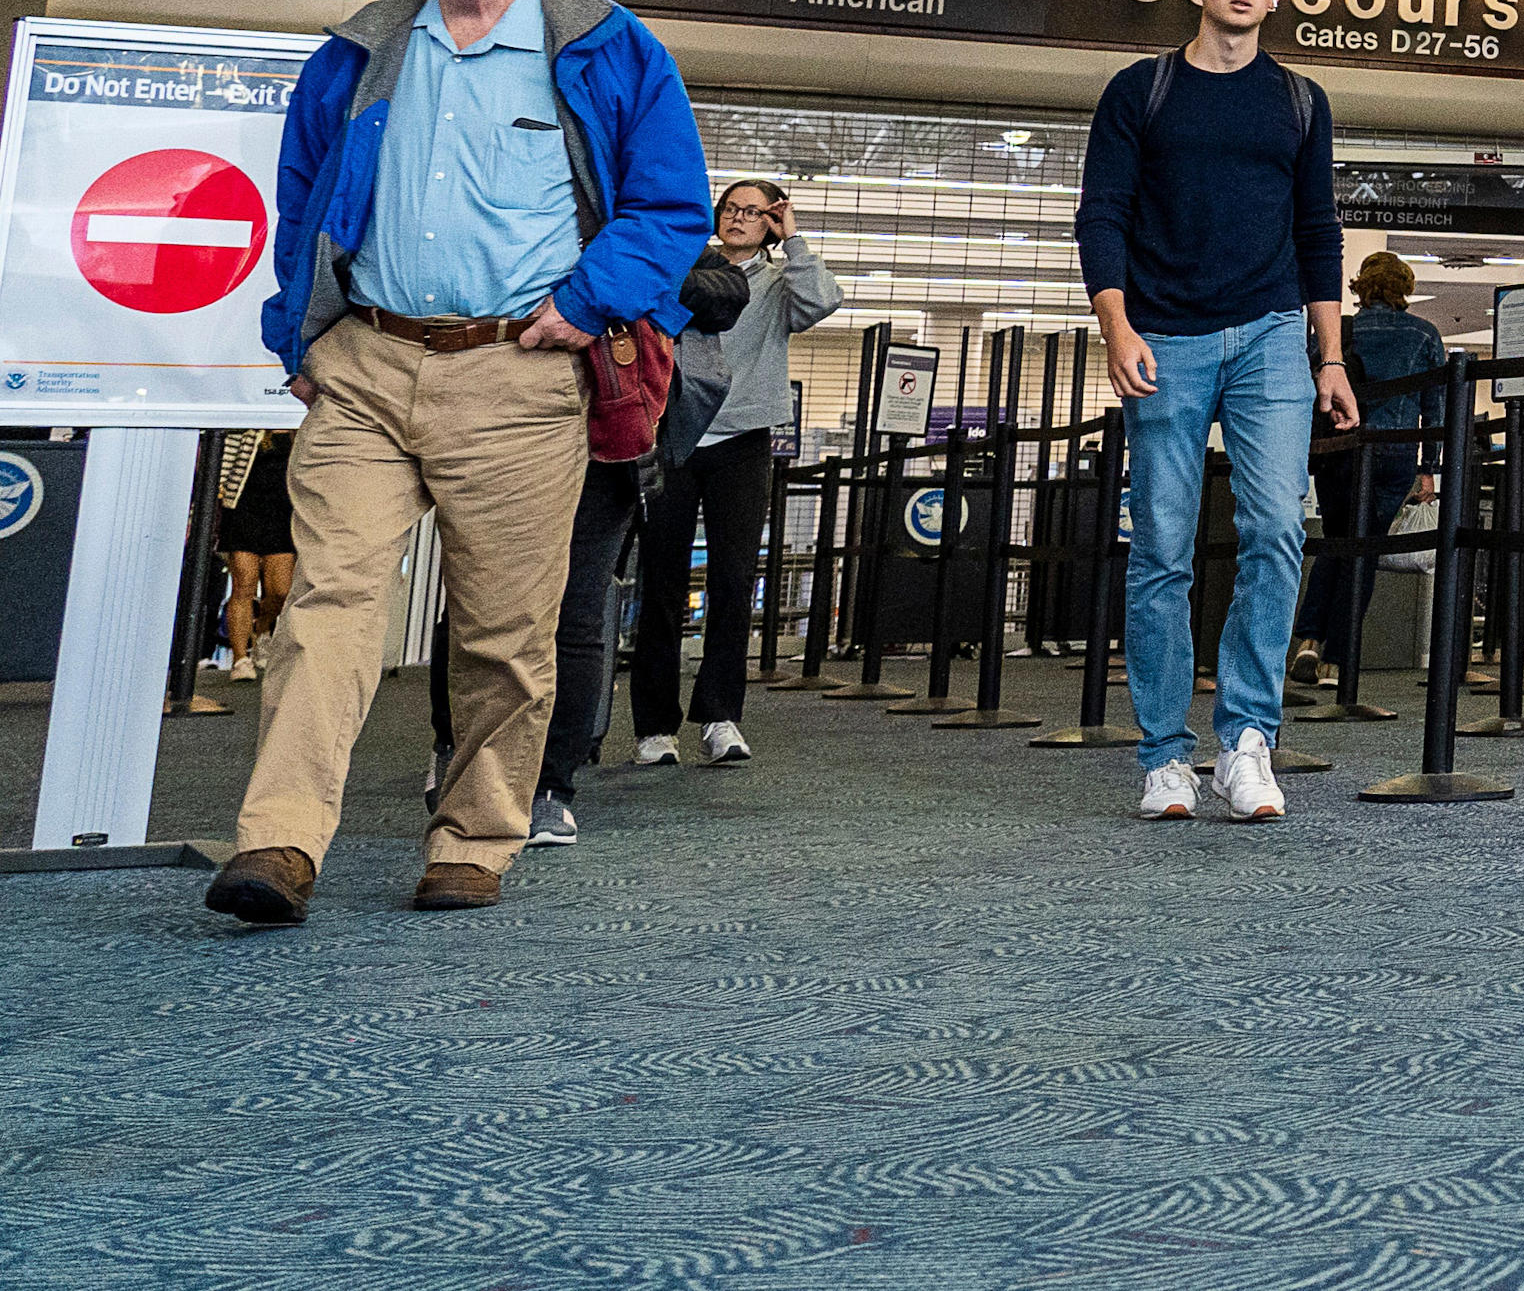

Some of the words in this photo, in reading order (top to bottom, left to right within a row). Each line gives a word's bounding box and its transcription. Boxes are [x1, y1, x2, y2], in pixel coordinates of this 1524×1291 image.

[1295, 21, 1379, 51] Gates
[44, 72, 80, 95] Do
[84, 74, 130, 98] Not
[134, 78, 201, 102] Enter
[228, 84, 281, 106] Exit
[1334, 192, 1371, 206] YOND
[1409, 197, 1449, 210] POINT
[1336, 210, 1373, 223] JECT
[1375, 210, 1394, 224] TO
[1397, 211, 1453, 226] SEARCH
[37, 378, 73, 386] Security
[264, 388, 291, 396] tsa.go
